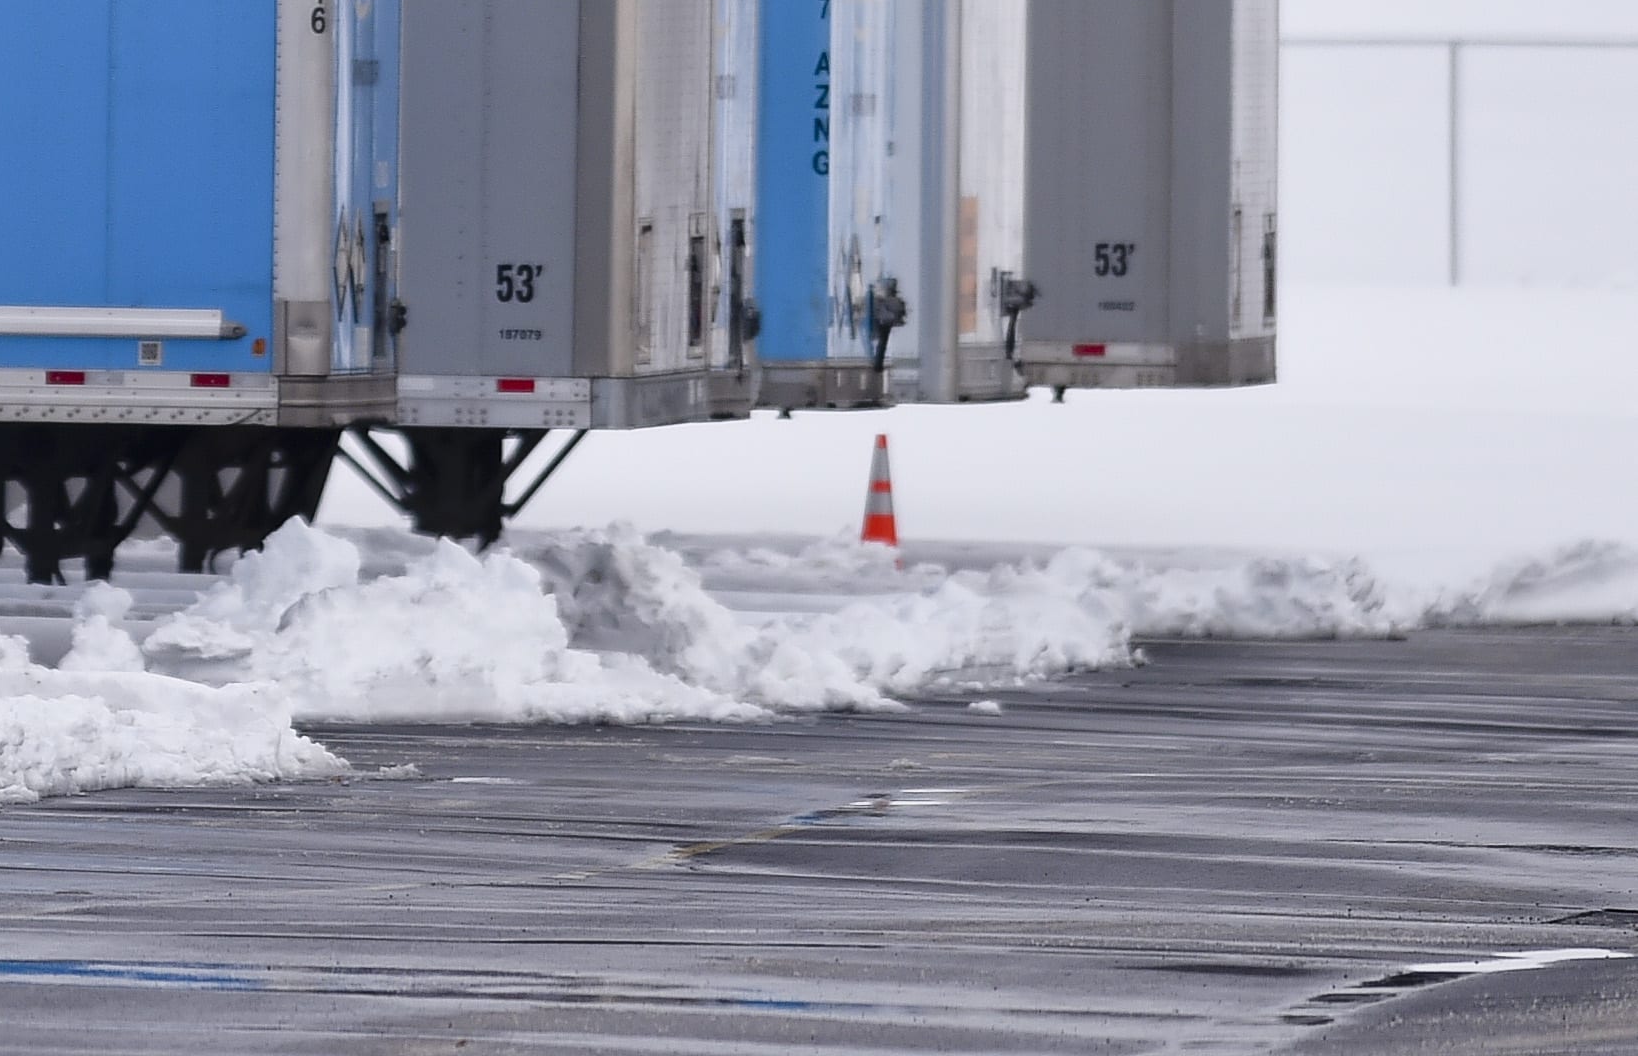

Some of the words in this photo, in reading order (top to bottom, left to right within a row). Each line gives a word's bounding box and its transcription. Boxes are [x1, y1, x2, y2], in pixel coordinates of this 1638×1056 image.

[812, 52, 831, 177] AZNG
[1095, 243, 1135, 277] 53'
[496, 264, 543, 303] 53'
